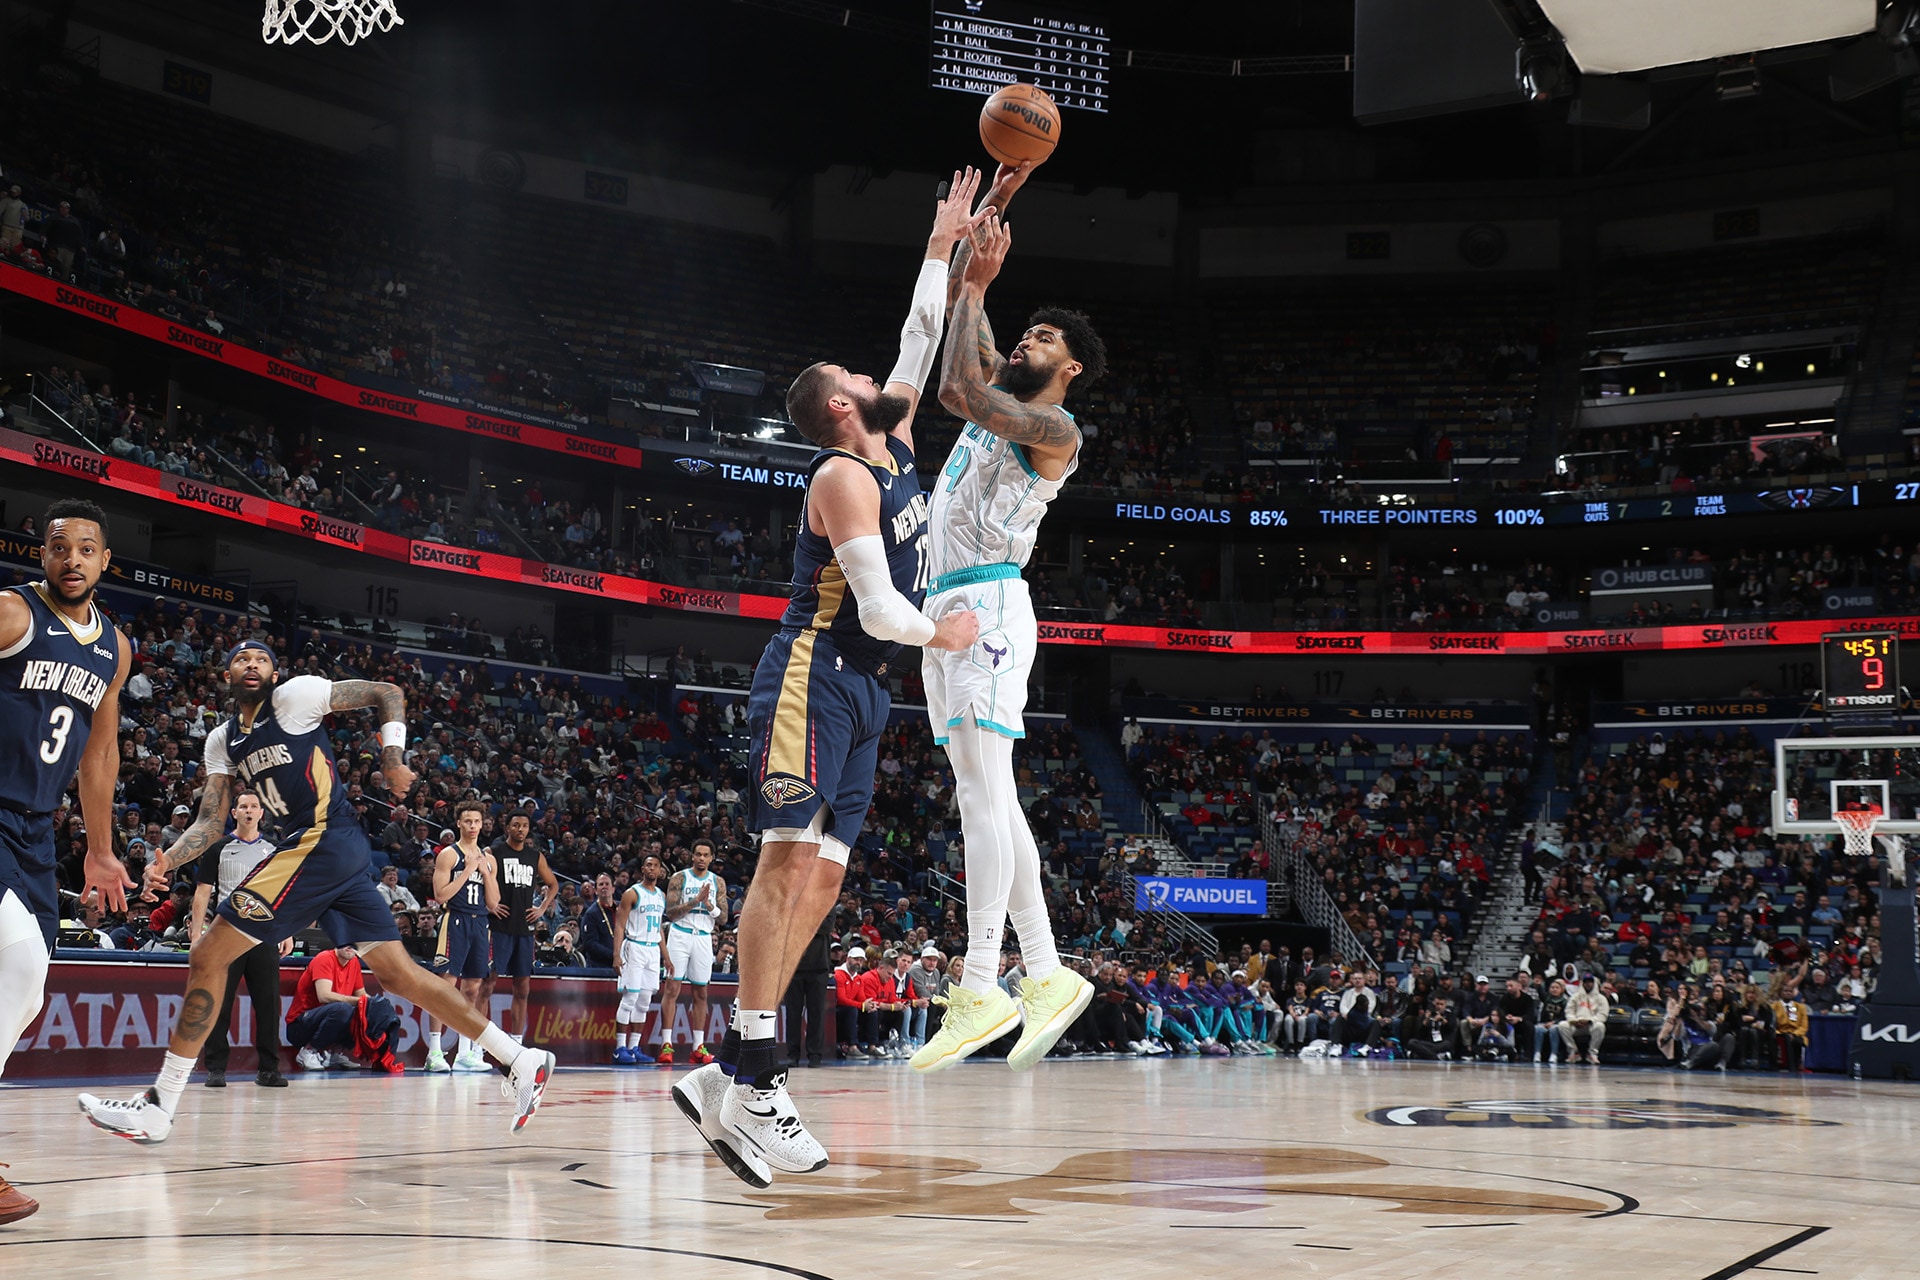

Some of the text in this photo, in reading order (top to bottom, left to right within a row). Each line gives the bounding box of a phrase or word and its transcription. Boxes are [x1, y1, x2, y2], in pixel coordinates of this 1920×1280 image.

[943, 20, 949, 28] 0
[955, 21, 964, 31] M.
[968, 24, 1013, 38] BRIDGES
[1034, 17, 1105, 36] PT RB AS BK FL
[965, 37, 989, 48] BALL
[964, 51, 1002, 65] ROZIER
[939, 77, 949, 87] 11
[965, 66, 1018, 83] RICHARDS
[1003, 101, 1052, 135] Wilson
[55, 287, 119, 322] SEATGEEK
[167, 326, 224, 358] SEATGEEK
[267, 360, 318, 391] SEATGEEK
[359, 391, 418, 417] SEATGEEK
[418, 389, 459, 403] PLAYERS PASS
[477, 403, 577, 430] PLAYER-FUNDED COMMUNITY TICKETS
[465, 415, 521, 440] SEATGEEK
[565, 437, 617, 461] SEATGEEK
[33, 442, 111, 481] SEATGEEK
[945, 445, 971, 493] 4
[720, 463, 809, 489] TEAM STA
[176, 481, 244, 515] SEATGEEK
[1584, 502, 1608, 512] TIME
[1697, 495, 1723, 505] TEAM
[1116, 503, 1288, 526] FIELD GOALS 85%
[1319, 509, 1545, 525] THREE POINTERS 100%
[1584, 501, 1672, 522] OUTS 7 2
[1695, 505, 1726, 516] FOULS
[300, 514, 359, 546] SEATGEEK
[891, 502, 918, 545] NEW
[0, 540, 40, 560] RIVE
[412, 544, 481, 572] SEATGEEK
[134, 569, 235, 602] BETRIVERS
[541, 567, 605, 592] SEATGEEK
[1623, 568, 1705, 583] HUB CLUB
[366, 584, 399, 617] 115
[659, 588, 726, 611] SEATGEEK
[1554, 610, 1579, 620] HUB
[1037, 625, 1105, 642] SEATGEEK
[1167, 632, 1233, 649] SEATGEEK
[1296, 636, 1364, 650] SEATGEEK
[1430, 636, 1500, 650] SEATGEEK
[1565, 632, 1634, 649] SEATGEEK
[1703, 626, 1778, 643] SEATGEEK
[93, 644, 113, 660] ibotta
[1844, 639, 1888, 657] 4:51
[1313, 670, 1345, 696] 117
[1862, 658, 1884, 690] 9
[19, 660, 108, 712] NEW ORLEAN
[1658, 704, 1768, 716] BETRIVERS
[1846, 695, 1895, 705] TISSOT
[1210, 706, 1310, 717] BETRIVERS
[1371, 708, 1474, 719] BETRIVERS
[40, 705, 75, 764] 3
[247, 744, 293, 775] ORLEANS
[255, 777, 290, 817] 14
[466, 883, 479, 905] 11
[1174, 887, 1258, 905] FANDUEL
[534, 1006, 574, 1044] Like
